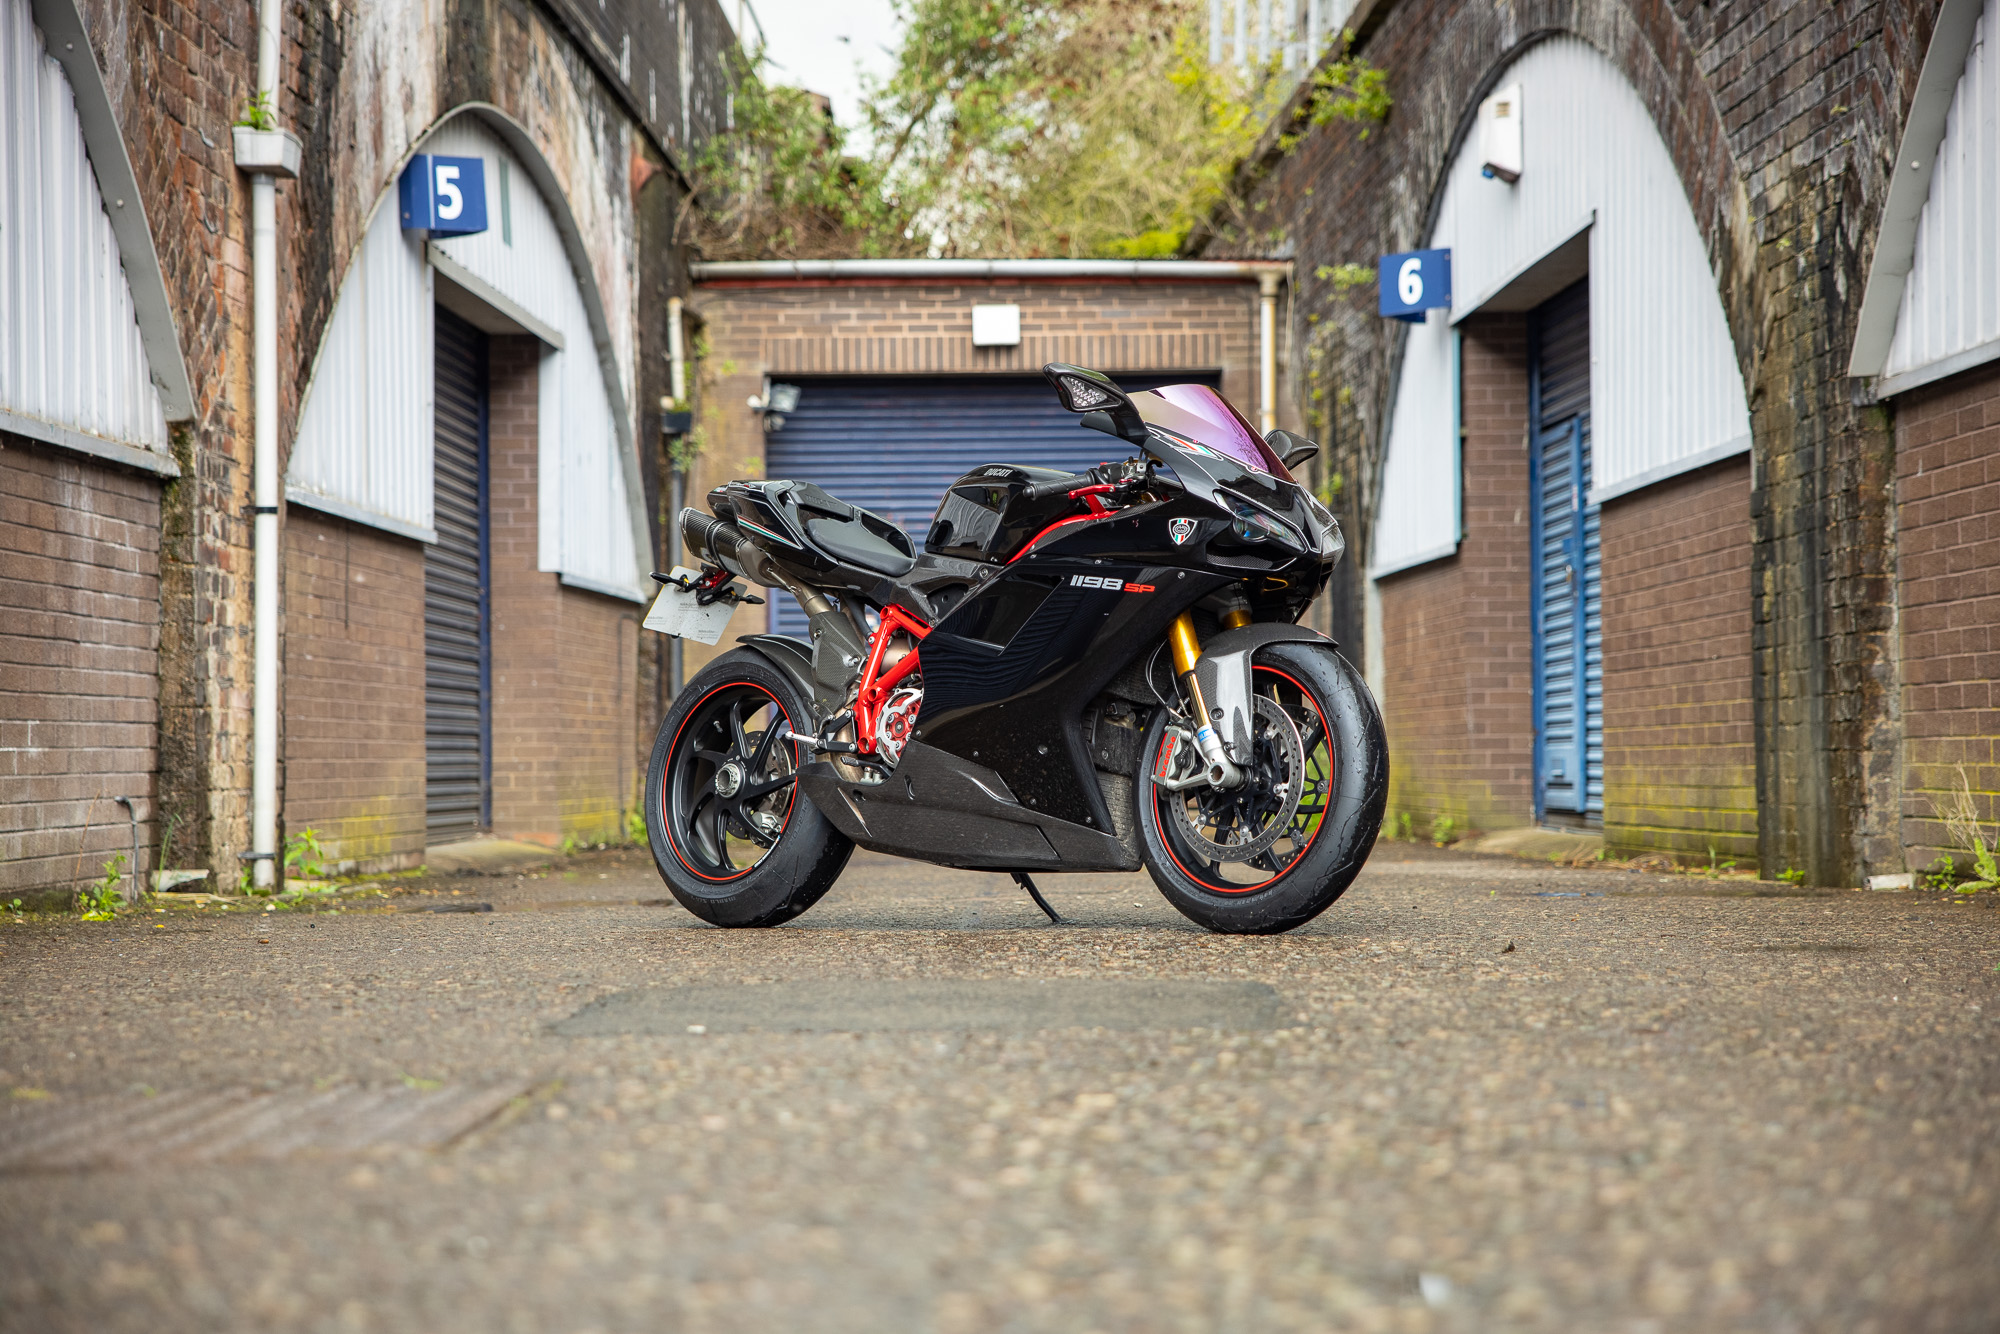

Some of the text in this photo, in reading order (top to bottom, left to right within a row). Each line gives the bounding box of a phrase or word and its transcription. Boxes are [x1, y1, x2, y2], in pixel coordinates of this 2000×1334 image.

[435, 165, 463, 220] 5
[1397, 257, 1423, 305] 6
[983, 468, 1013, 477] DUCATI
[1069, 574, 1156, 593] 1198 SP
[1158, 736, 1177, 778] brembo
